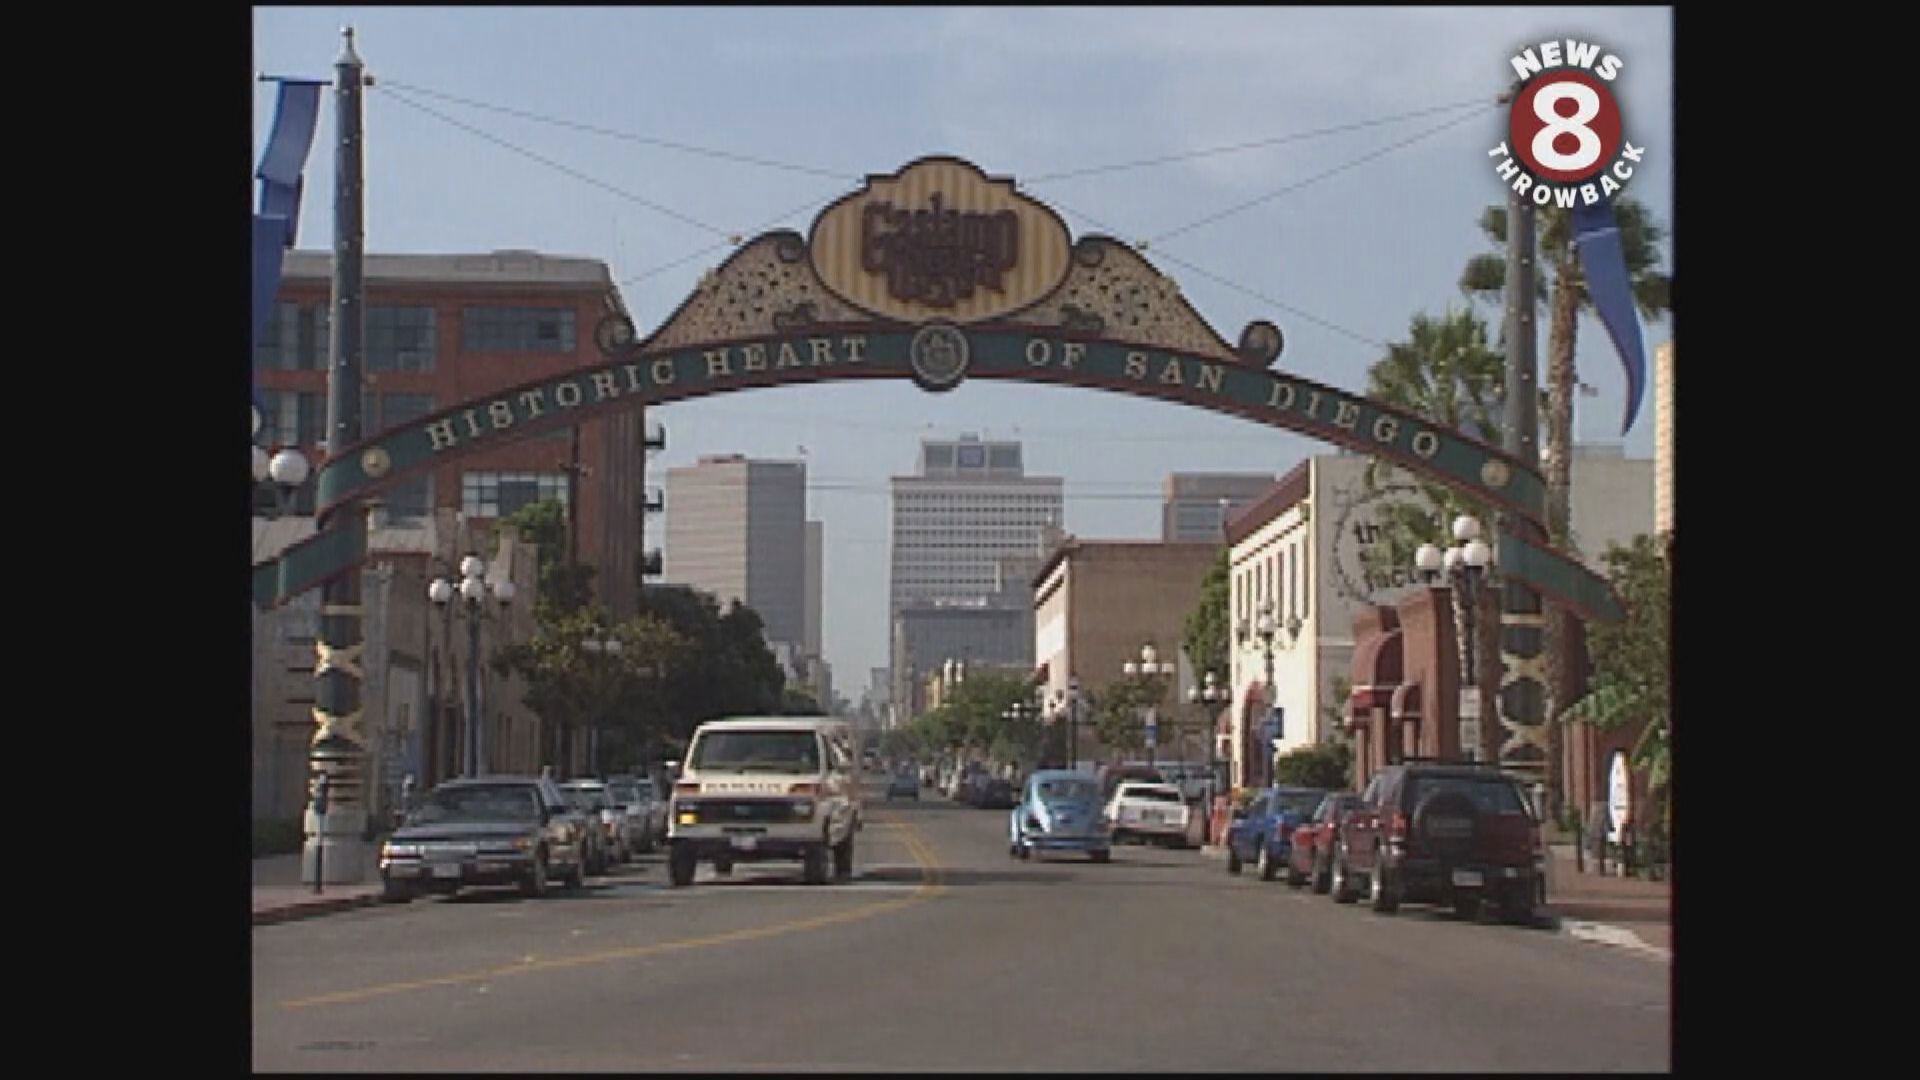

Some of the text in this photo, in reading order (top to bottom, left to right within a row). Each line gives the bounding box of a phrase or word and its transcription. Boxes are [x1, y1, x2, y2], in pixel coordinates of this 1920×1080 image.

[424, 336, 1440, 458] HISTORIC HEART OF SAN DIEGO
